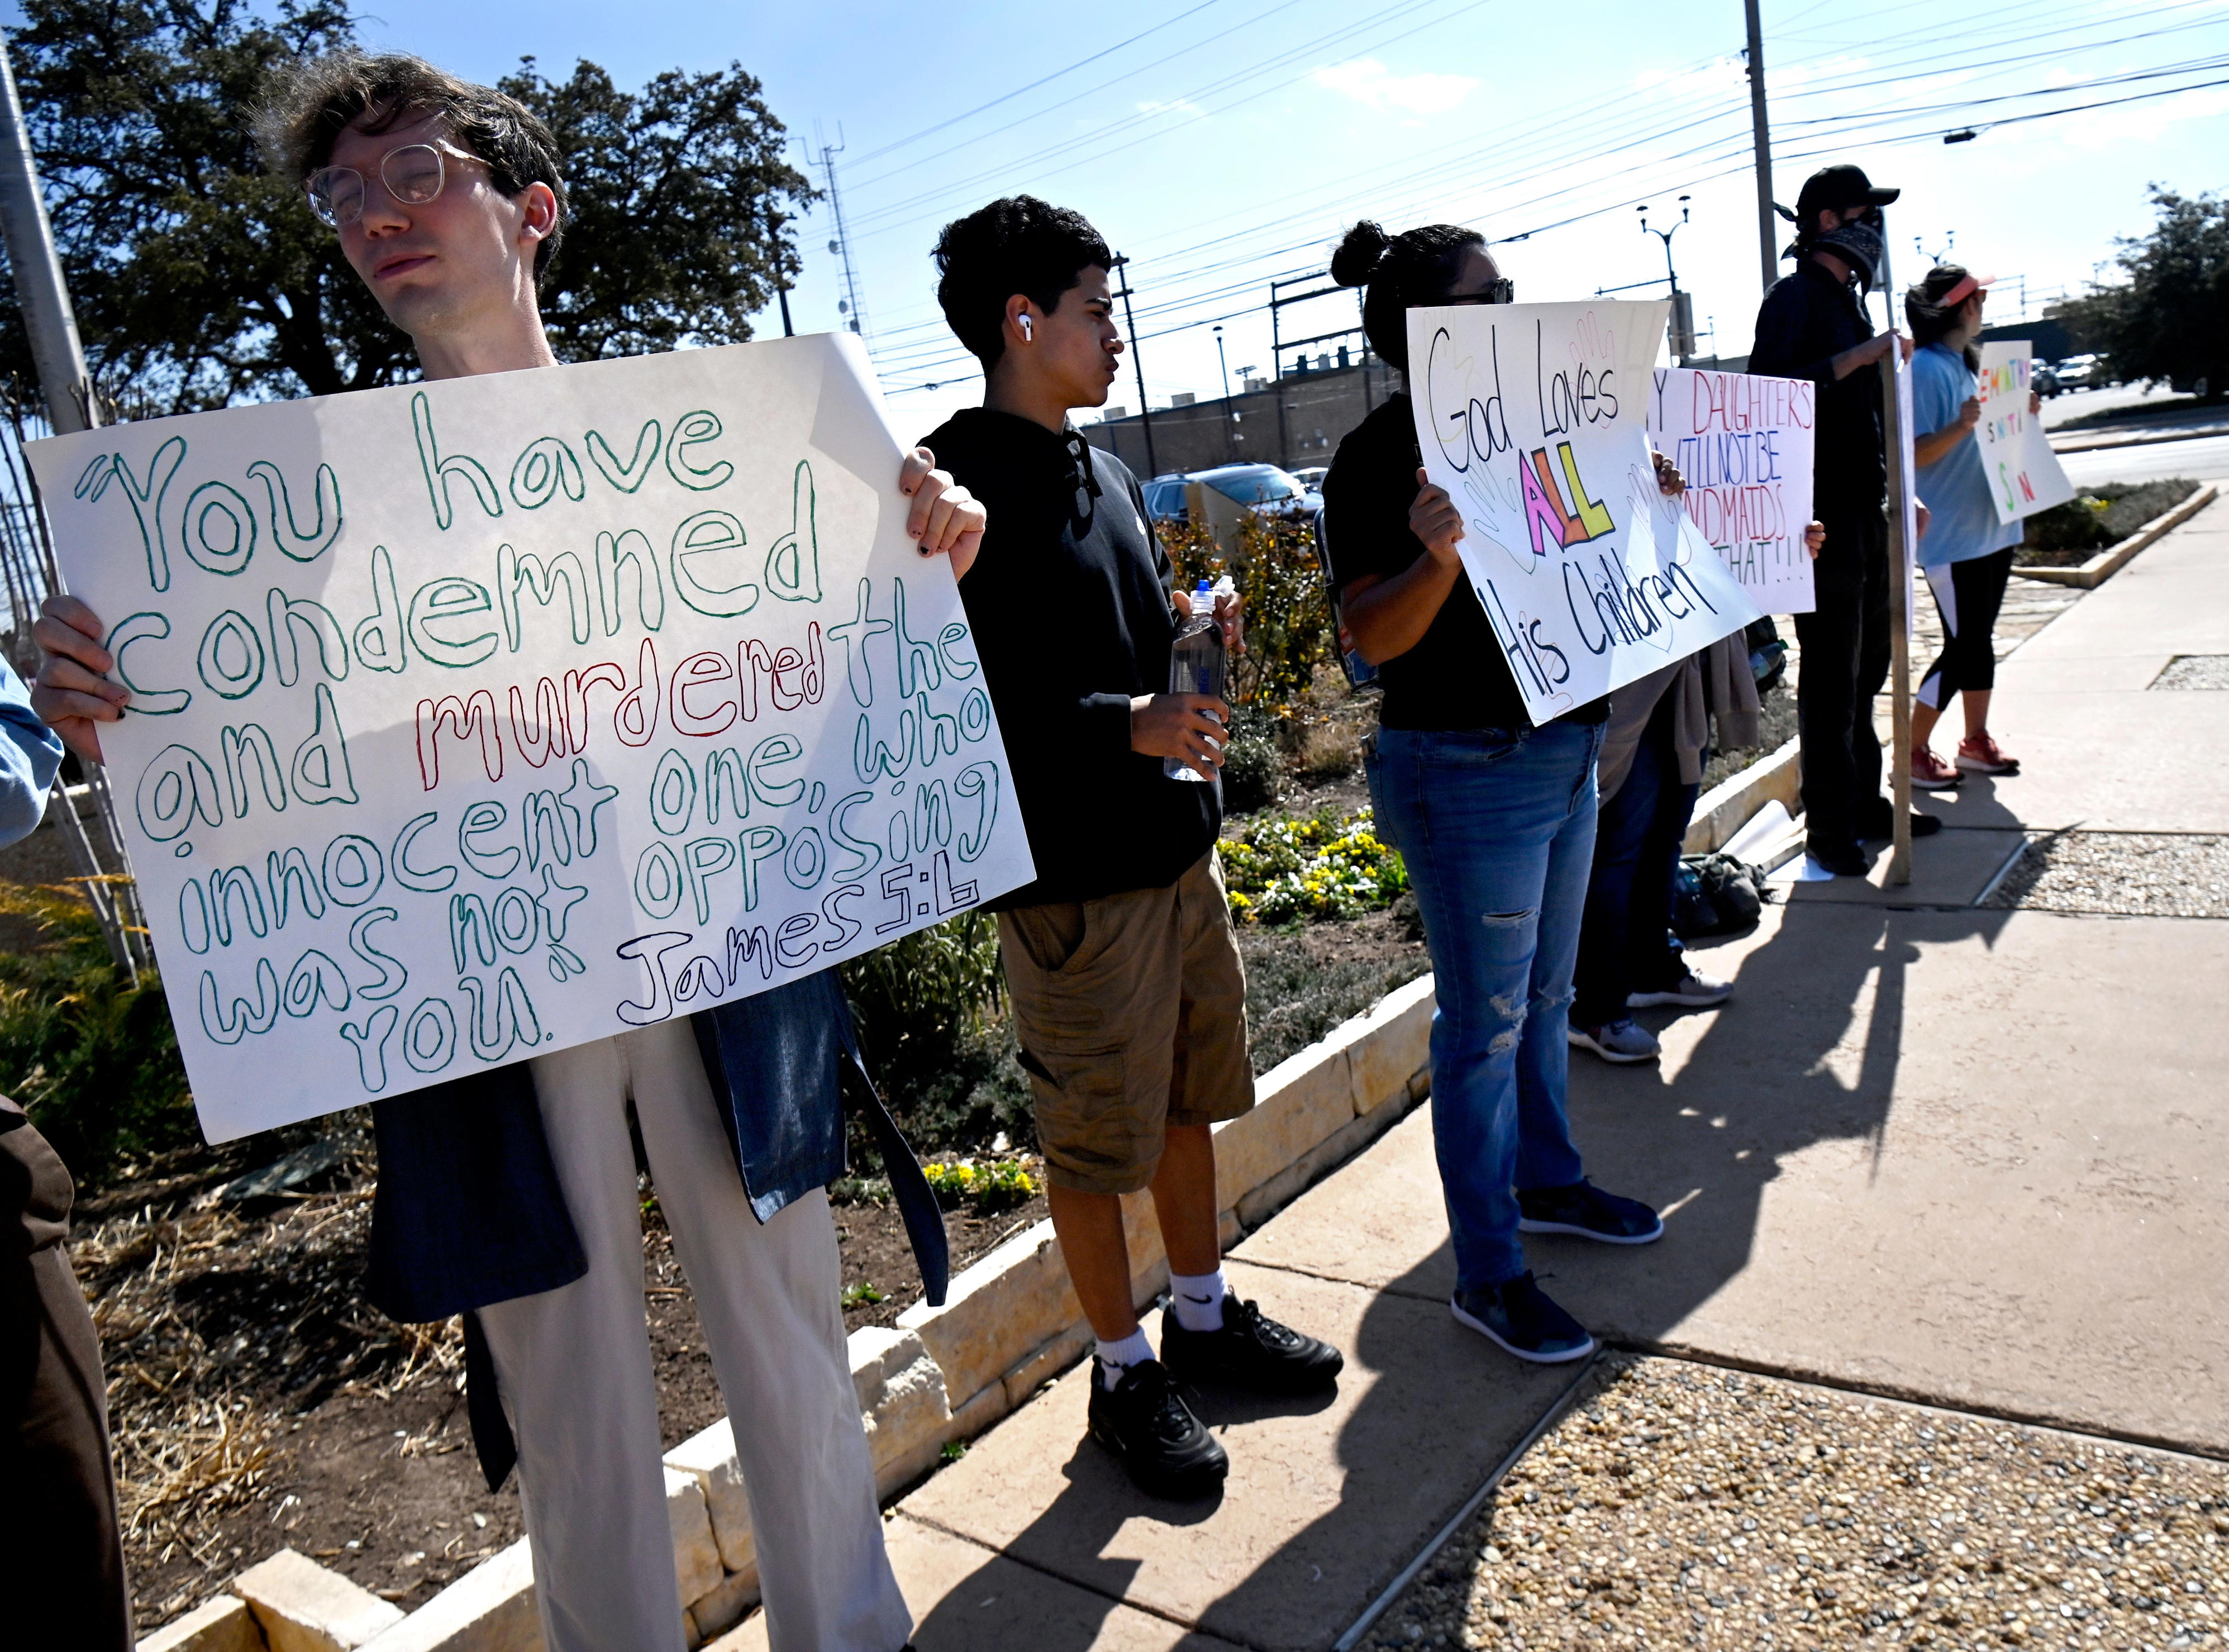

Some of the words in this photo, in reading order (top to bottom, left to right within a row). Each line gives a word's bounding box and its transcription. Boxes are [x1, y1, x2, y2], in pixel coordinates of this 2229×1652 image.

[412, 391, 734, 530] have
[1428, 325, 1513, 474] God
[1537, 318, 1618, 437] Loves
[1646, 370, 1668, 432] Y
[1693, 371, 1813, 434] DAUGHTERS
[1755, 431, 1782, 482] BE
[1519, 441, 1616, 556] ALL
[1685, 484, 1786, 546] NDMAIDS
[106, 459, 823, 715] condemned
[1477, 579, 1570, 703] His
[1564, 548, 1718, 655] Children
[136, 683, 359, 842] and
[417, 621, 825, 791] murdered
[827, 577, 978, 708] the
[175, 758, 619, 954] innocent
[650, 733, 826, 835] one,
[855, 687, 989, 783] who
[200, 906, 408, 1045] was
[450, 863, 588, 974] not
[634, 760, 999, 926] opposing
[616, 885, 865, 1025] James
[876, 850, 979, 935] 5:6
